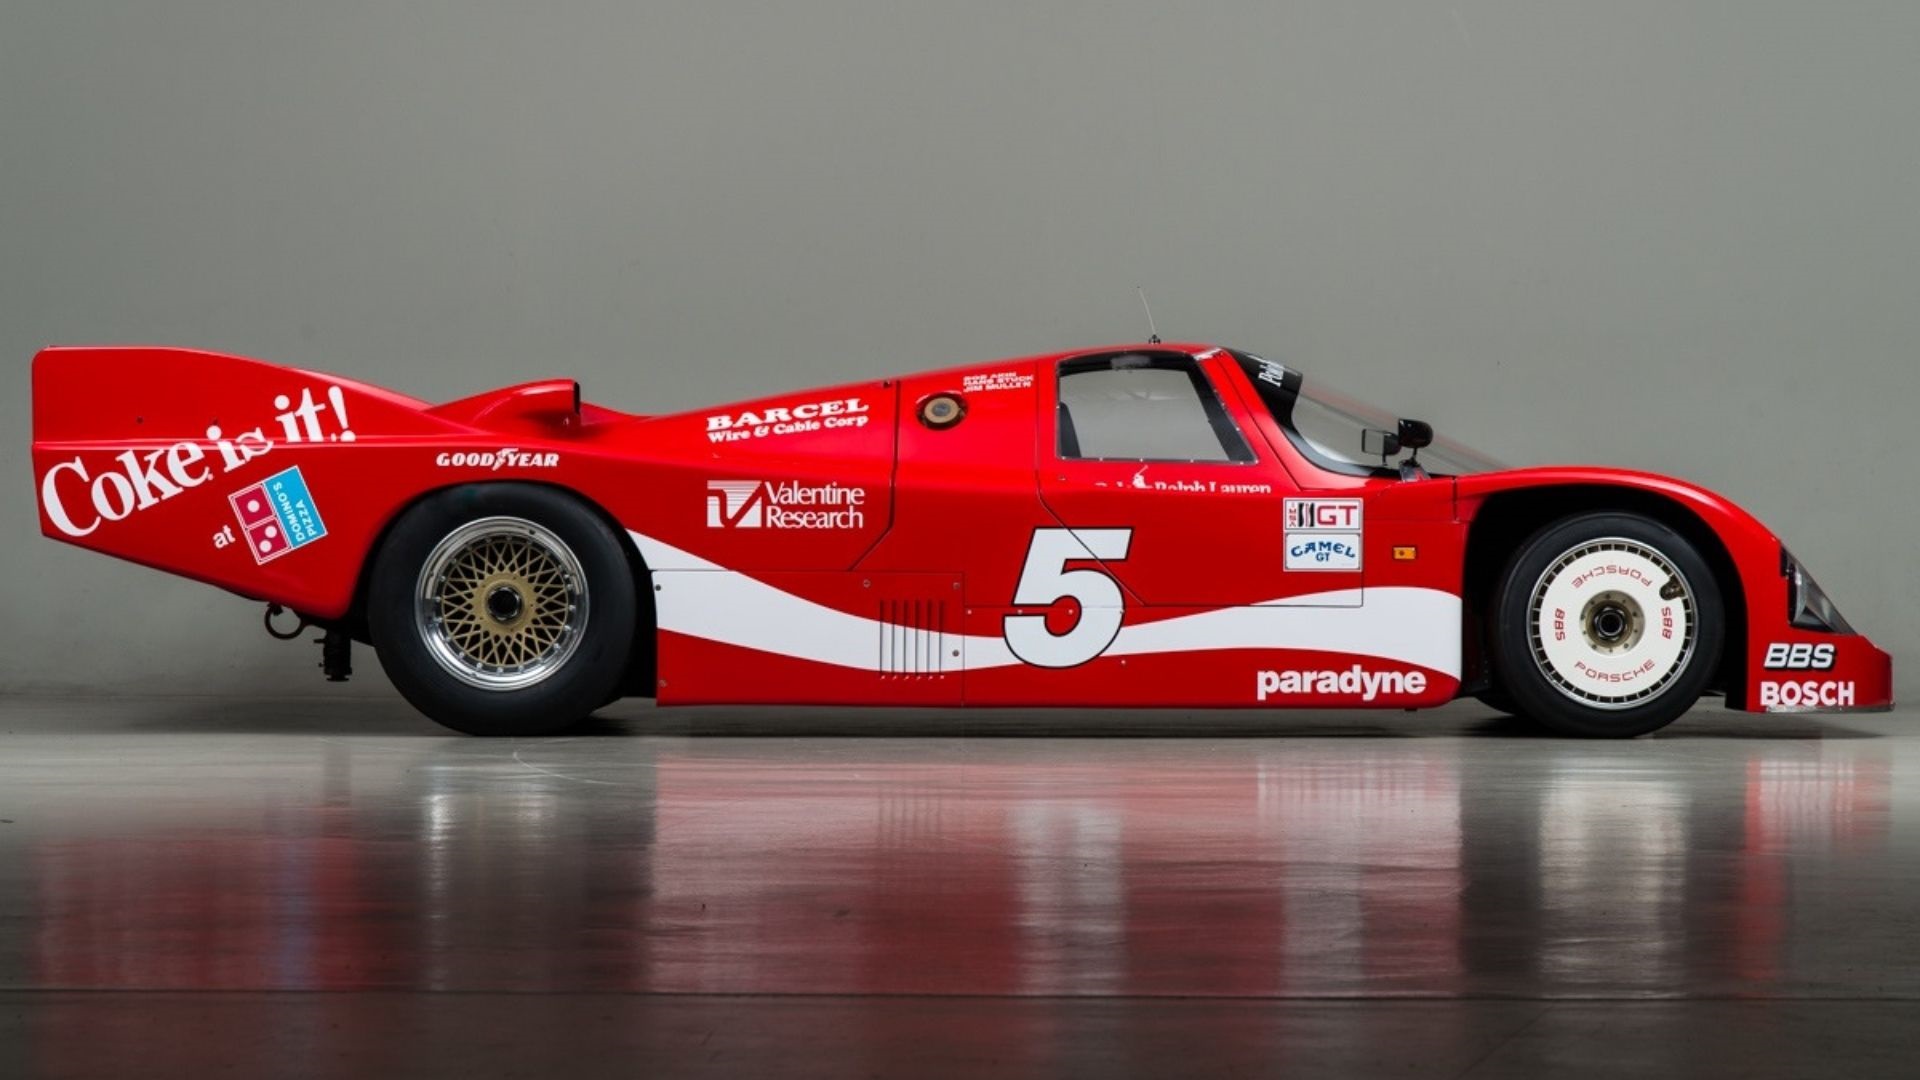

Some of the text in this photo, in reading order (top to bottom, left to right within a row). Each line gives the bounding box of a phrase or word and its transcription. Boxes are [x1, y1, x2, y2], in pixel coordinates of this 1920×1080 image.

[706, 398, 870, 431] BARCEL
[707, 415, 869, 444] Wire & Cable Corp
[42, 385, 356, 537] Coke is it!
[436, 450, 560, 468] GOODYEAR
[765, 480, 865, 505] Valentine
[273, 481, 306, 542] DOMINO'S
[296, 499, 318, 537] PIZZA
[766, 505, 864, 528] Research
[1317, 505, 1358, 525] GT
[213, 524, 236, 549] at
[1291, 541, 1355, 558] CAMEL
[1316, 552, 1330, 562] GT
[1571, 564, 1653, 589] PORSCHE
[1003, 527, 1135, 669] 5
[1554, 607, 1566, 641] BBS
[1660, 606, 1673, 640] BBS
[1764, 643, 1837, 670] BBS
[1257, 664, 1427, 700] paradyne
[1574, 658, 1656, 683] PORSCHE
[1760, 681, 1855, 707] BOSCH
